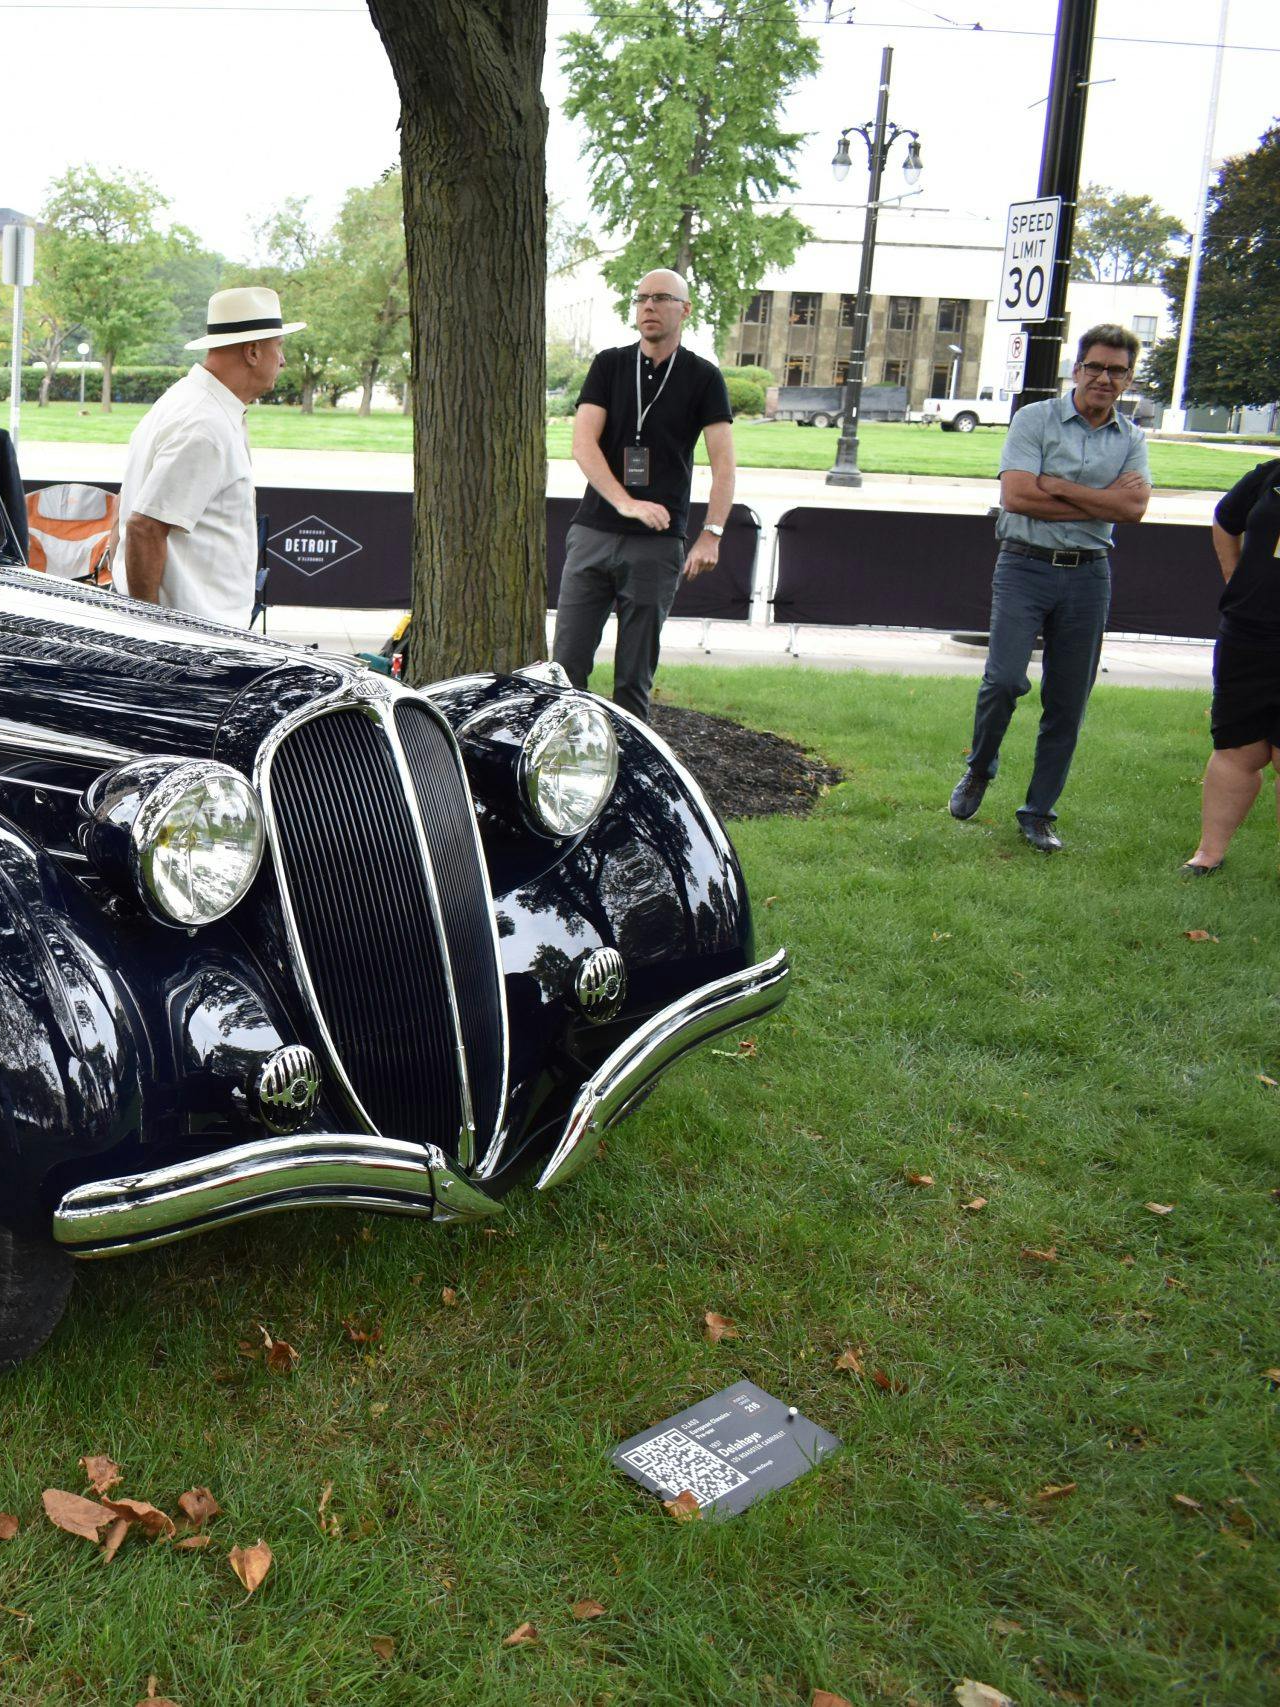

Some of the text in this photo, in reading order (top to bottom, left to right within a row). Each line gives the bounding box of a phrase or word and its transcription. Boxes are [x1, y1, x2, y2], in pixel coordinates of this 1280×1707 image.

[1011, 213, 1054, 234] SPEED
[1013, 239, 1046, 259] LIMIT
[1005, 265, 1044, 309] 30
[284, 538, 338, 554] DETROIT
[744, 1402, 761, 1413] 216
[717, 1432, 762, 1457] Delahaye
